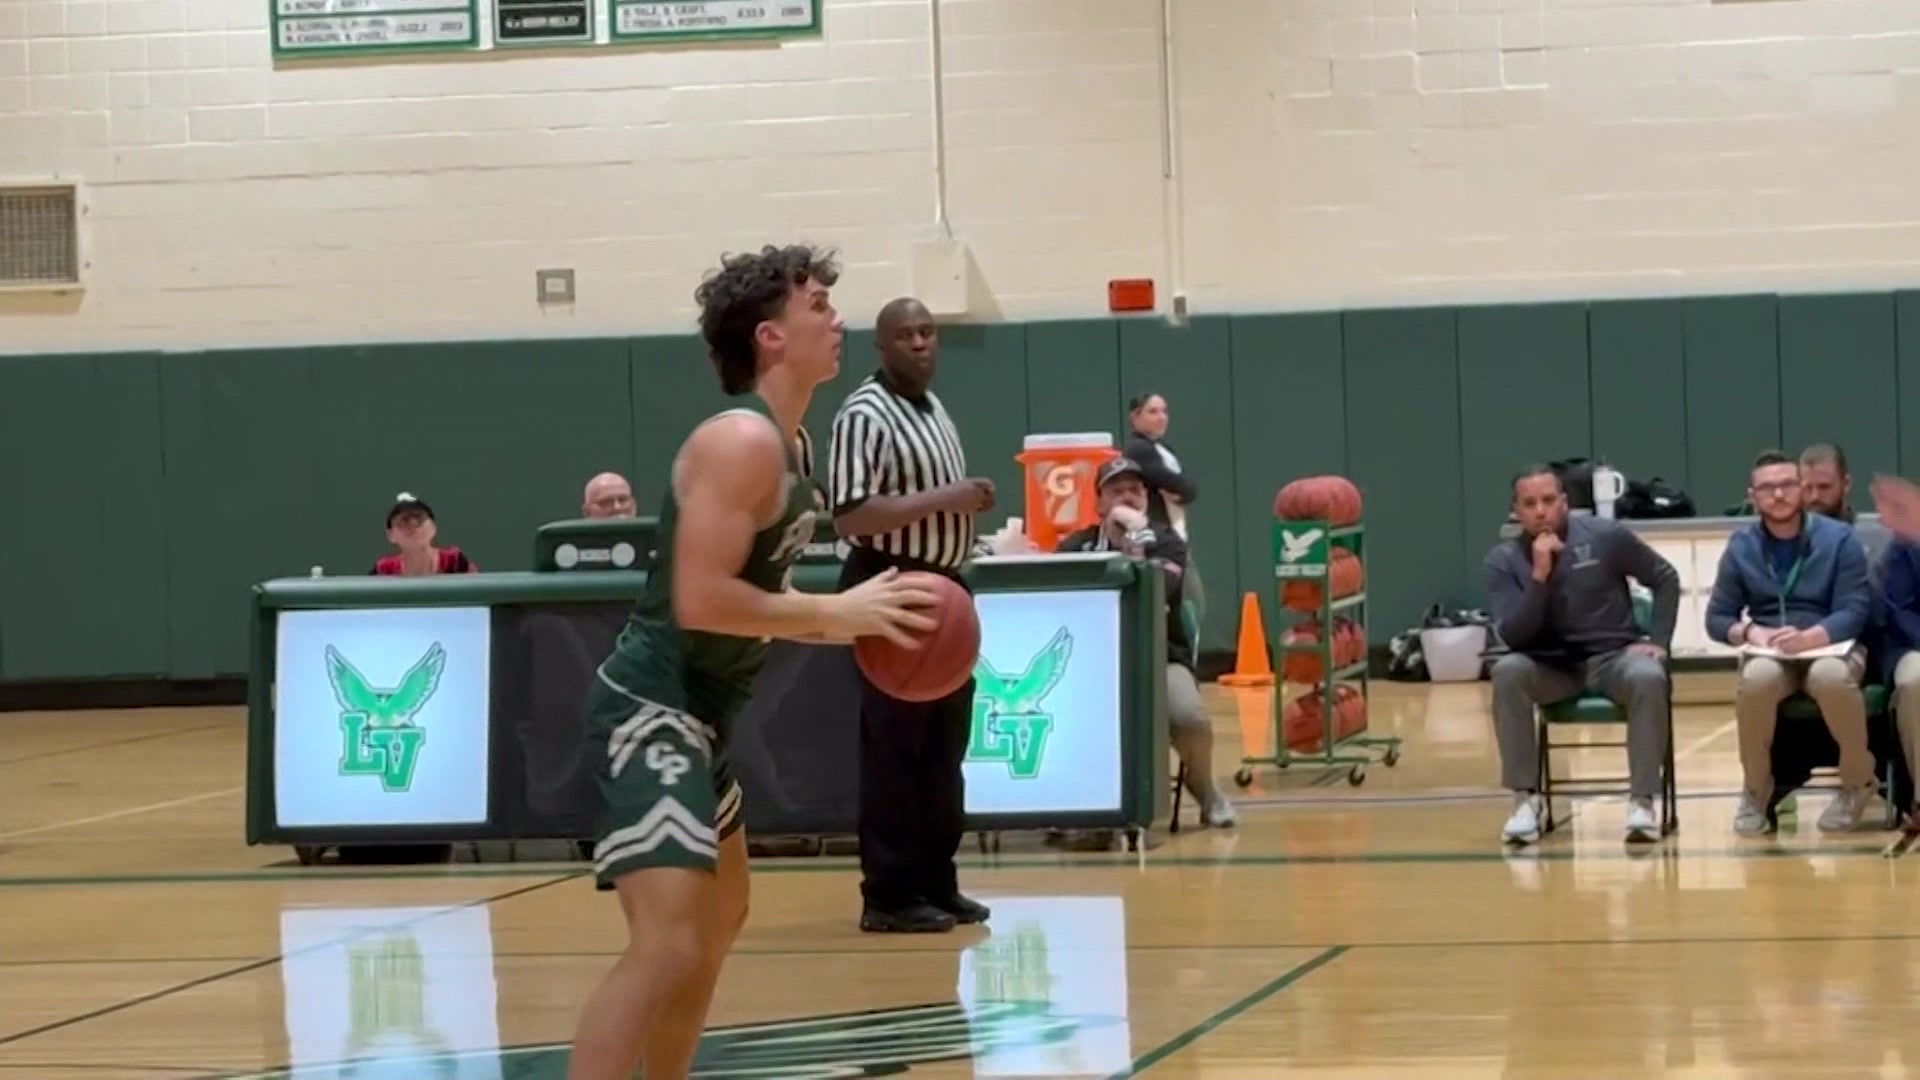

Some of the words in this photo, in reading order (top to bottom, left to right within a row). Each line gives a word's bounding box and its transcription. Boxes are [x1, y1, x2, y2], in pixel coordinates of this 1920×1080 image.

[1047, 465, 1075, 496] G
[339, 712, 426, 792] LV
[646, 741, 691, 785] CP
[963, 697, 1053, 780] LV
